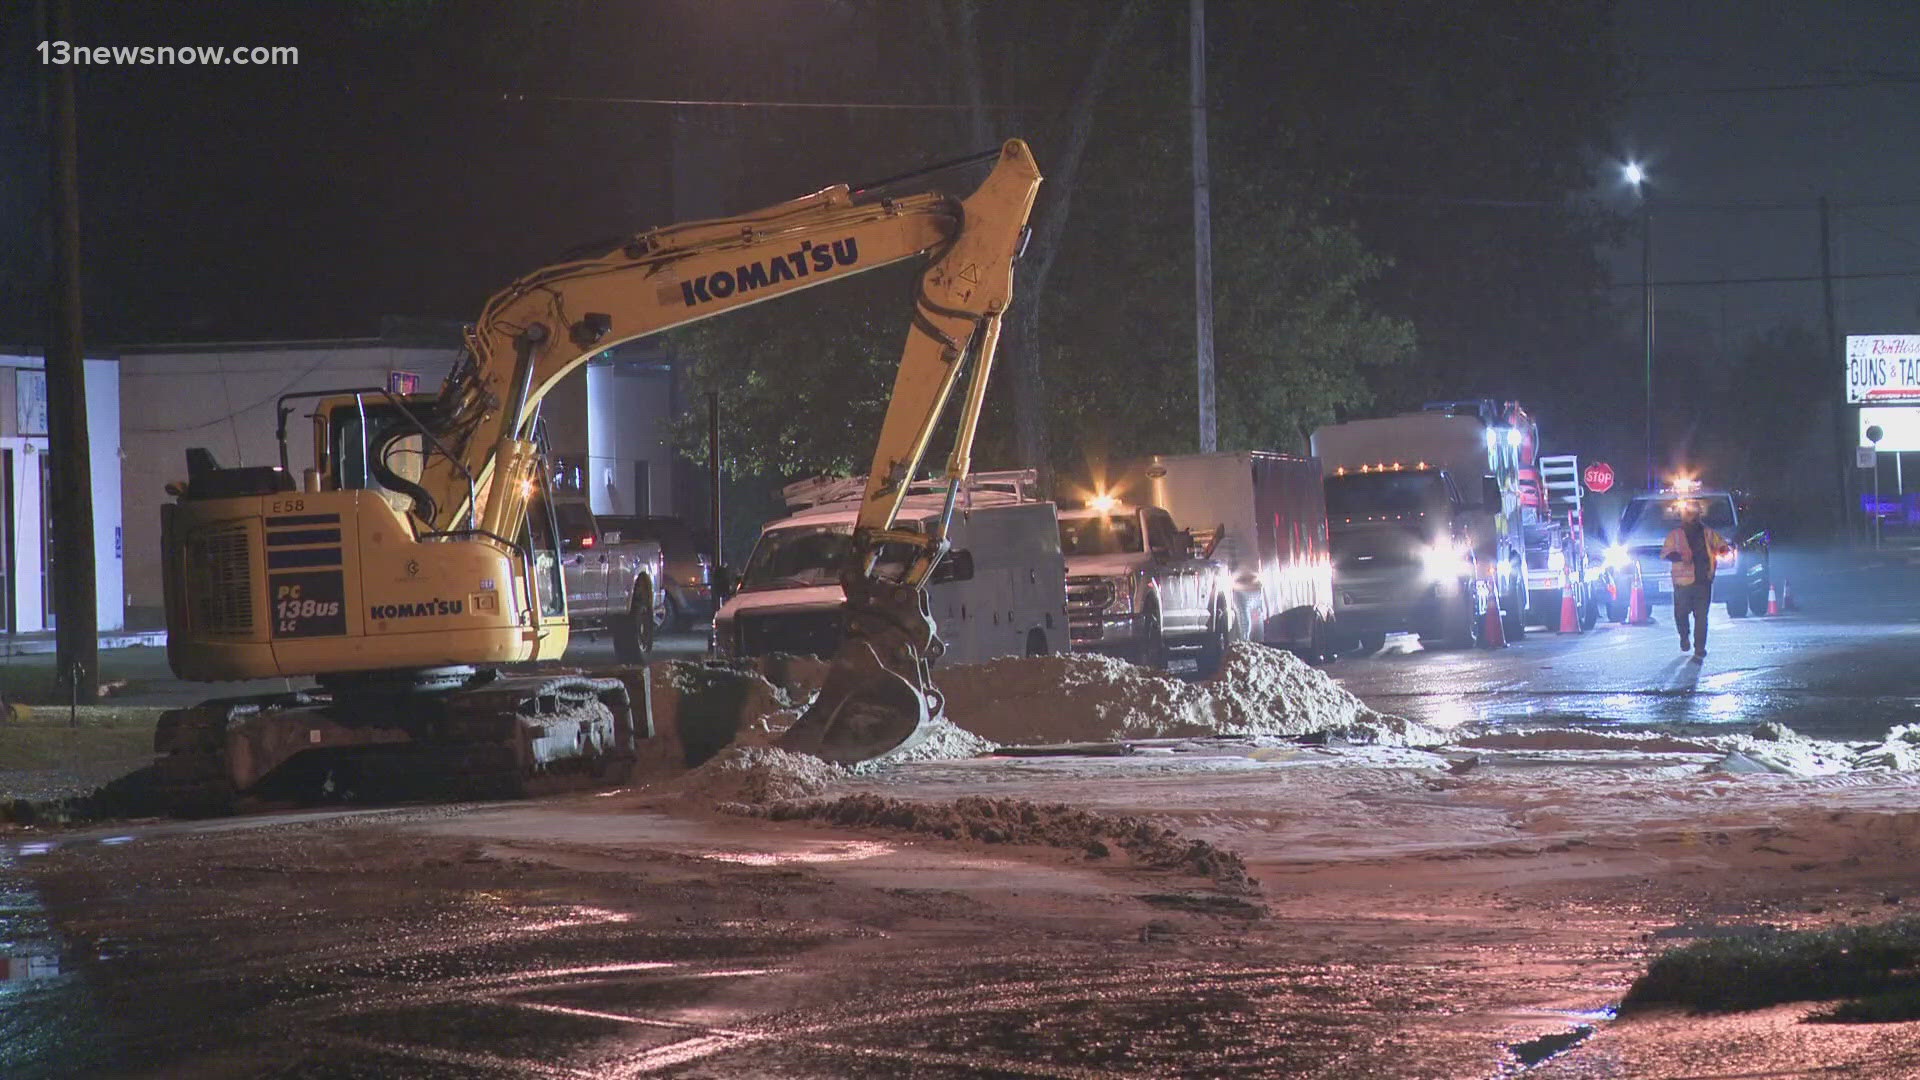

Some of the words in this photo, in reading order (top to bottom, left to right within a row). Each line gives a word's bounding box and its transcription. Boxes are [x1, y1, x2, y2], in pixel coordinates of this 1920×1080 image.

[680, 237, 859, 307] KOMATSU
[1851, 359, 1886, 386] GUNS
[1586, 471, 1612, 485] STOP
[278, 585, 300, 599] PC
[371, 598, 462, 620] KOMATSU
[280, 620, 296, 632] LC
